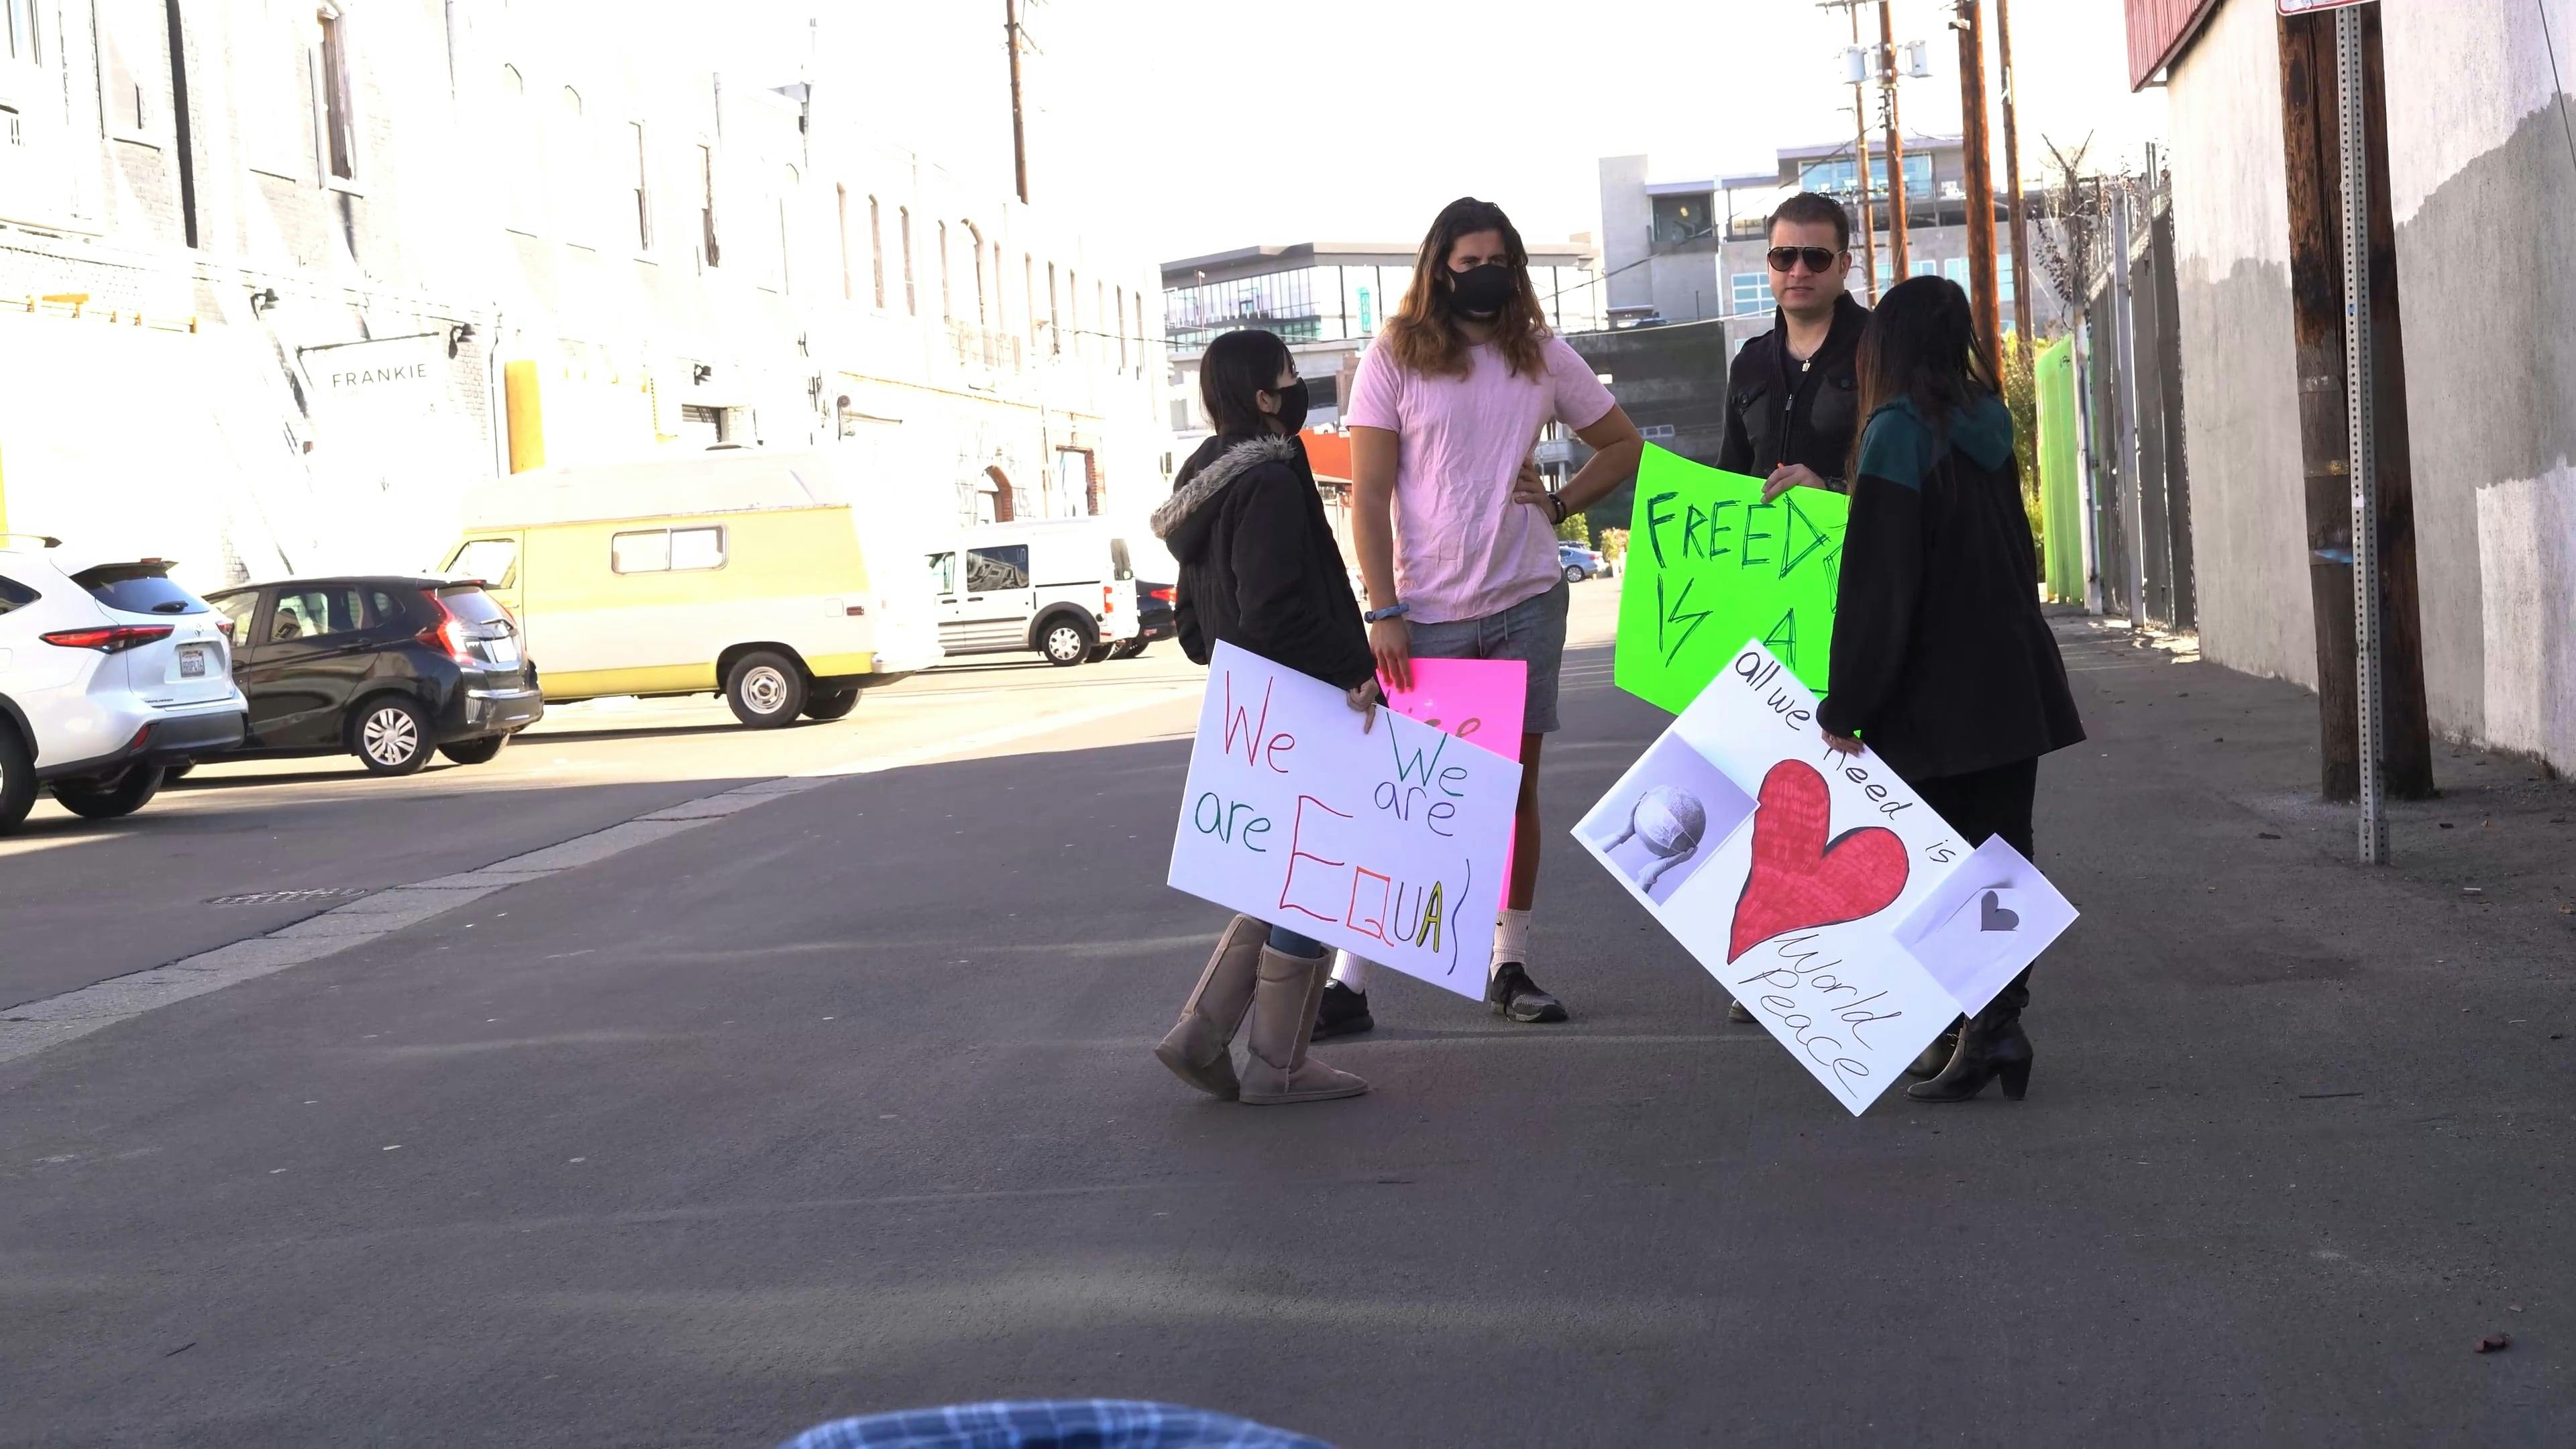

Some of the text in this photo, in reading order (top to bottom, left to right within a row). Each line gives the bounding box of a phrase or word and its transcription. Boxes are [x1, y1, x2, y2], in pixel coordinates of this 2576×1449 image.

[333, 364, 427, 388] FRANKIE
[1224, 671, 1295, 773] We
[1386, 711, 1468, 797] We
[1735, 651, 1780, 691] all
[1767, 686, 1810, 731] we
[1925, 840, 1957, 864] is
[1194, 792, 1271, 852] are
[1374, 781, 1456, 837] are
[1773, 934, 1902, 1051] World
